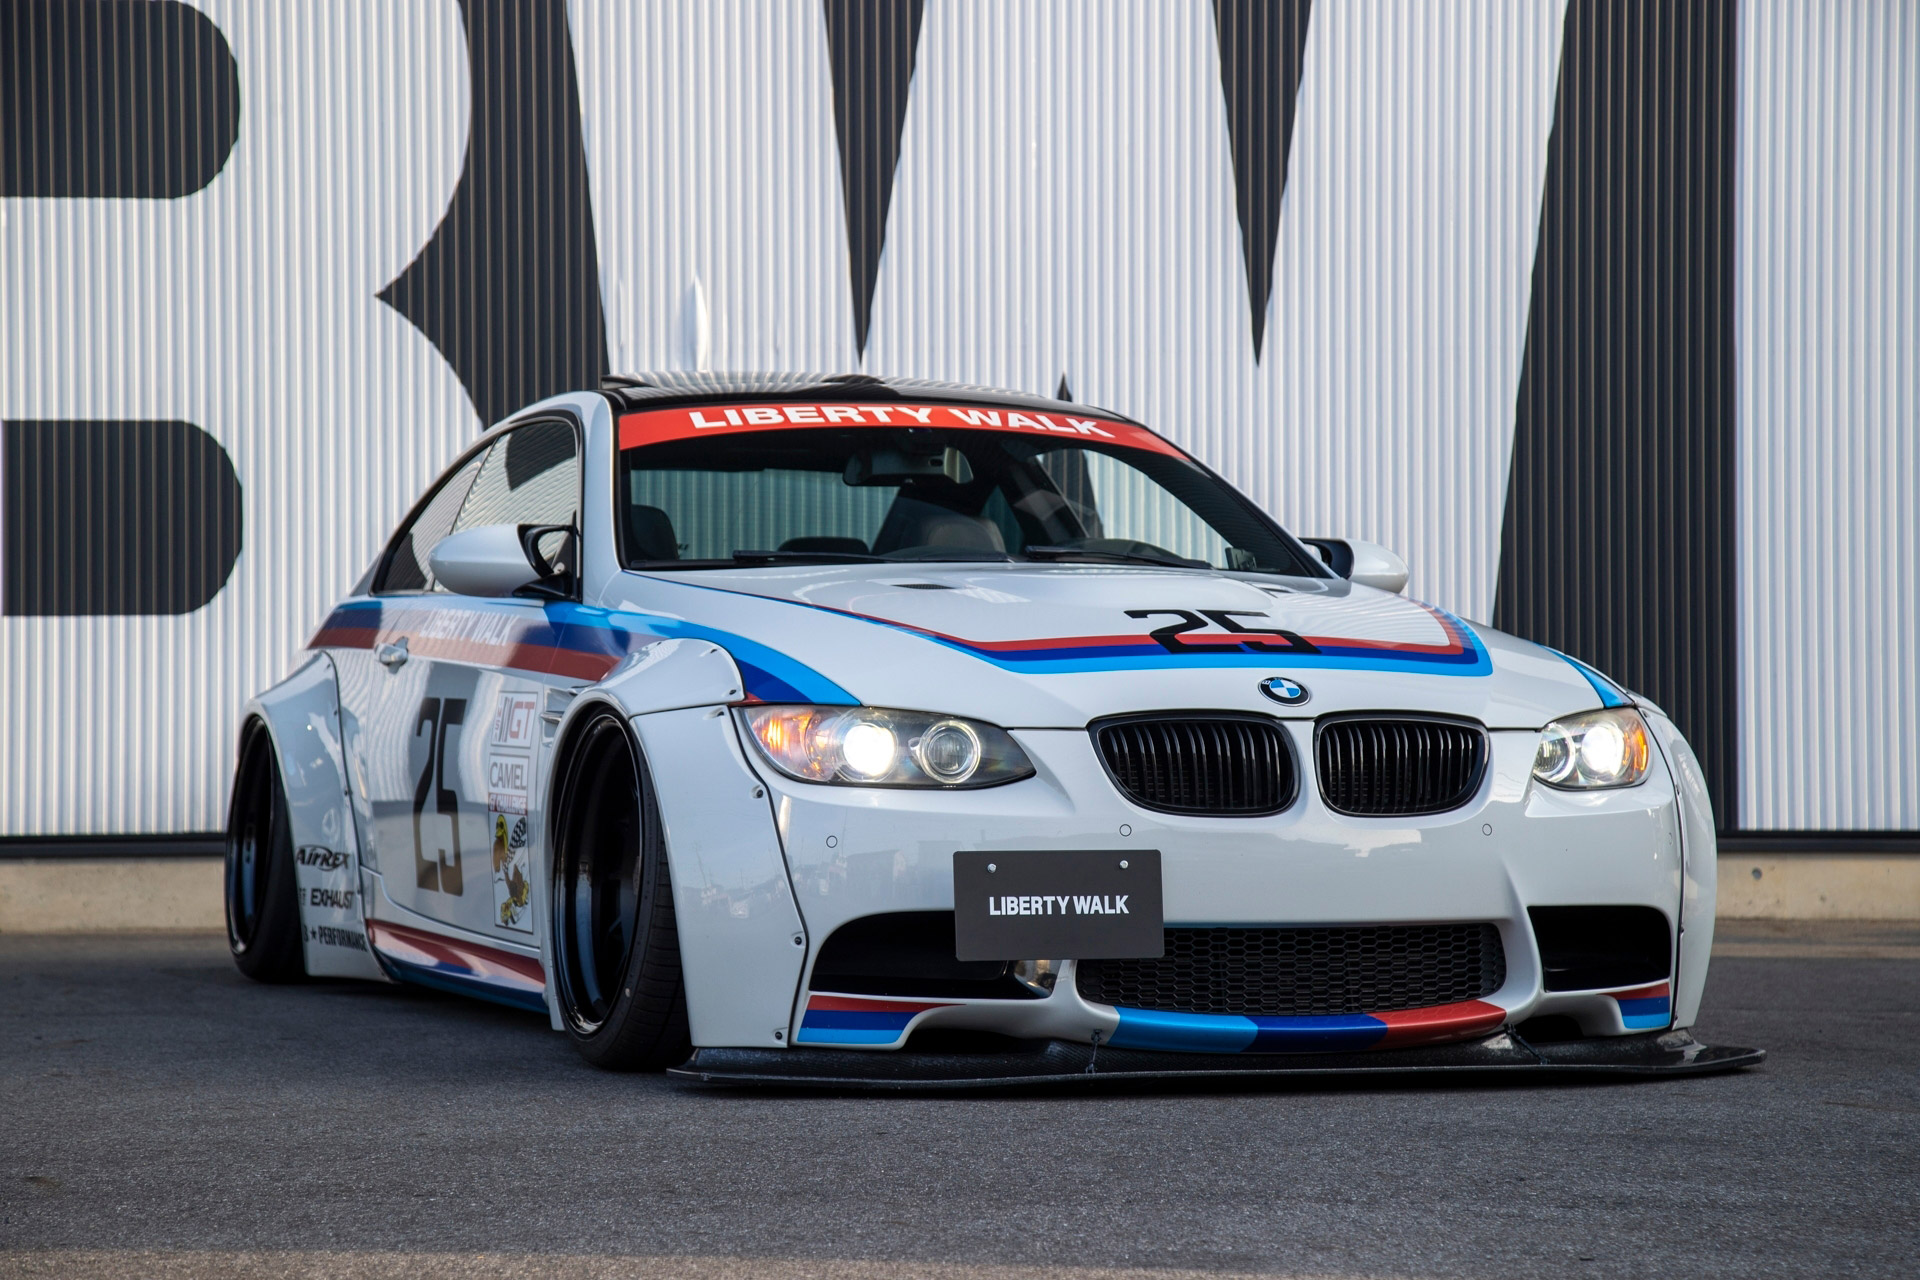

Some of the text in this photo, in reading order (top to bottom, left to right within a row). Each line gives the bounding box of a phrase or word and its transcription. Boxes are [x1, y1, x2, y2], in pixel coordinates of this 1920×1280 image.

[688, 406, 1116, 439] LIBERTY WALK
[419, 608, 521, 646] LIBERTY WALK
[1123, 609, 1323, 654] 25
[508, 701, 536, 740] GT
[489, 762, 527, 791] CAMEL
[412, 696, 467, 897] 25
[310, 887, 355, 910] EXHAUST
[989, 894, 1129, 916] LIBERTY WALK
